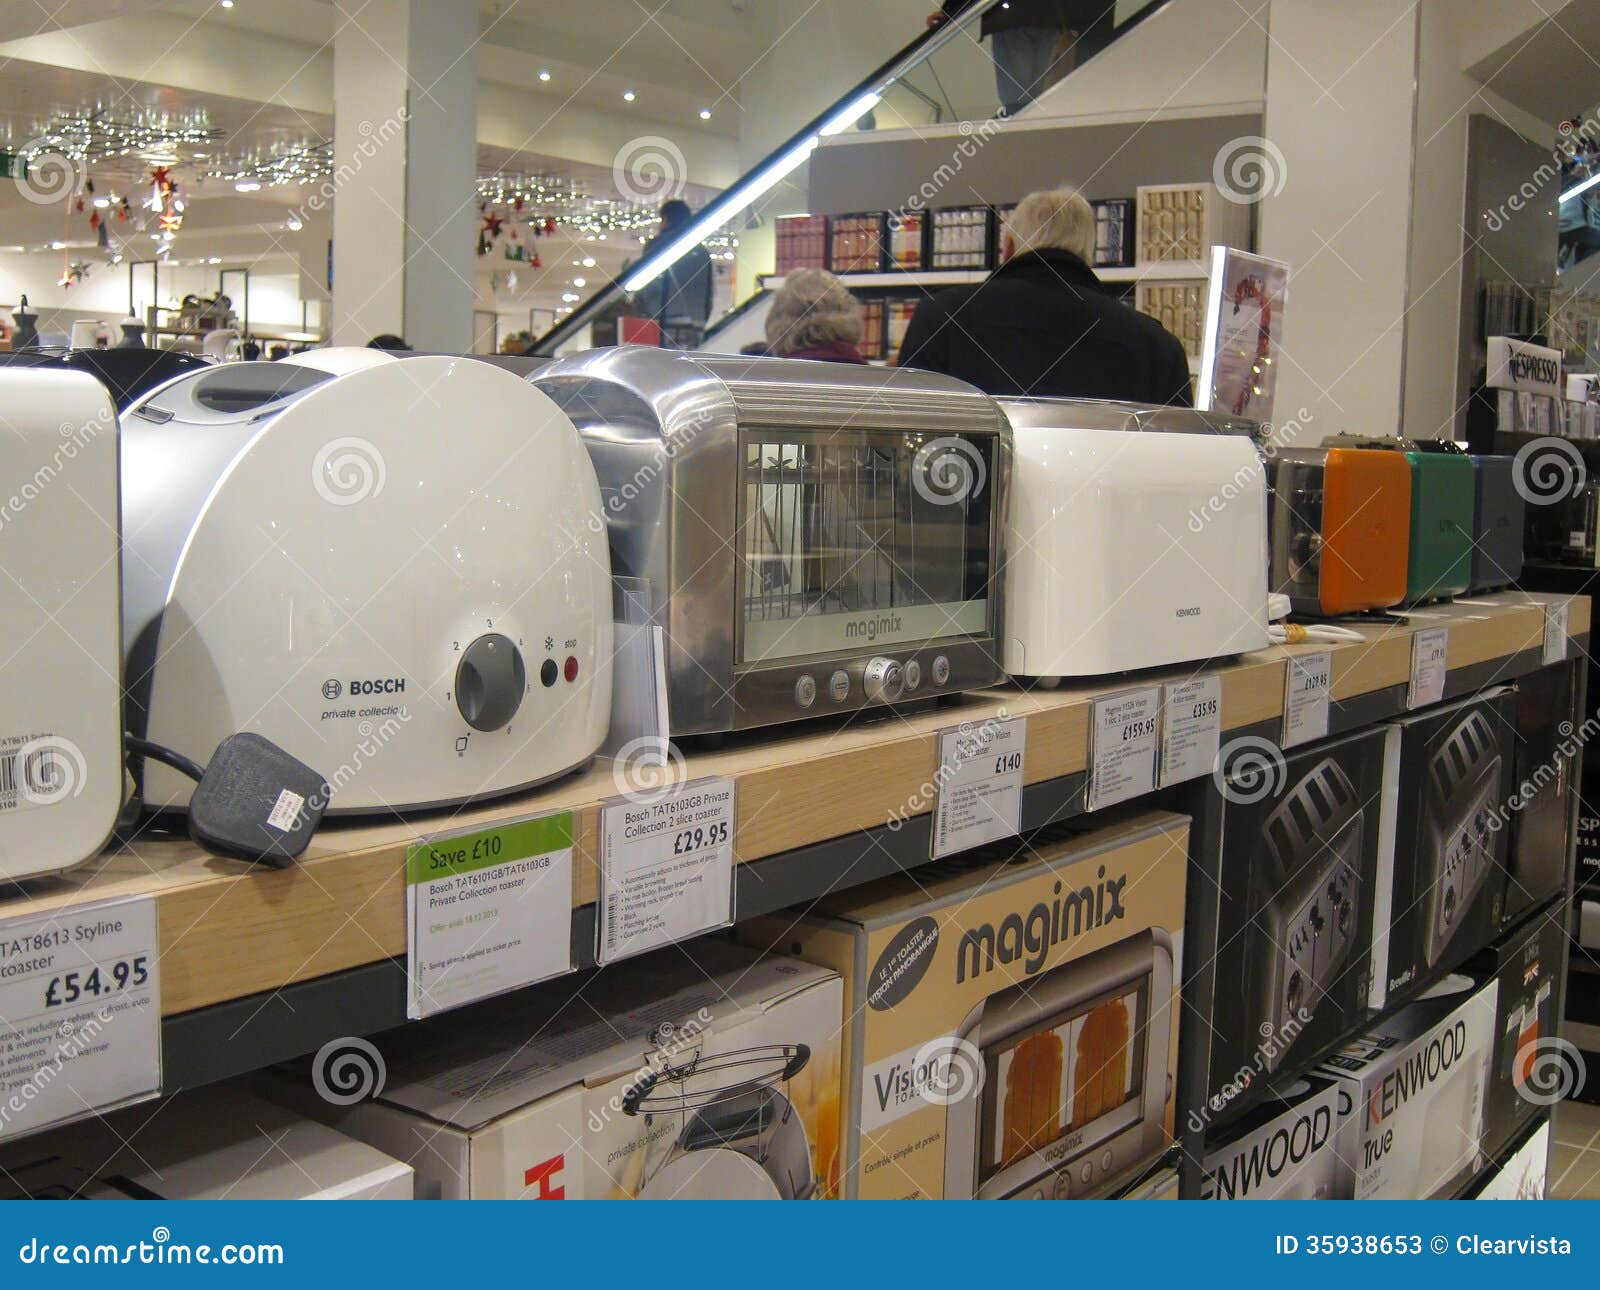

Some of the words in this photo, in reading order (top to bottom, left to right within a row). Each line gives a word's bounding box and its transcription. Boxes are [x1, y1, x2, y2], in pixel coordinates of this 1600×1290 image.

[1508, 344, 1558, 385] NESPRESSO
[845, 613, 902, 641] magimix
[453, 642, 460, 651] 2
[349, 678, 405, 696] BOSCH
[321, 708, 356, 720] private
[1193, 700, 1217, 719] £35.95
[1123, 718, 1155, 741] £159.95
[995, 753, 1021, 774] £140
[624, 820, 667, 839] Collection
[669, 816, 674, 828] 2
[676, 812, 693, 826] slice
[694, 806, 723, 820] toaster
[625, 808, 650, 824] Bosch
[652, 795, 702, 817] TAT6103GB
[703, 790, 730, 804] Private
[430, 848, 467, 870] Save
[472, 836, 502, 860] £10
[674, 821, 728, 855] £29.95
[430, 879, 454, 895] Bosch
[455, 856, 551, 891] TAT6101GB/TAT6103GB
[429, 891, 457, 908] Private
[458, 884, 498, 901] Collection
[499, 877, 526, 891] toaster
[0, 929, 70, 958] TAT8613
[75, 919, 123, 942] Styline
[956, 865, 1127, 984] magimix
[0, 955, 55, 979] toaster
[869, 975, 894, 1005] VISION
[892, 927, 939, 981] PANORAMIQUE
[879, 968, 888, 981] LE
[896, 928, 925, 962] TOASTER
[45, 956, 149, 1008] £54.95
[16, 1034, 52, 1050] memory
[27, 1019, 66, 1034] including
[873, 1057, 940, 1112] Vision
[1365, 1020, 1466, 1132] KENWOOD
[607, 1141, 637, 1165] private
[637, 1121, 676, 1149] collection
[892, 1144, 914, 1161] simple
[914, 1140, 922, 1151] et
[1044, 1132, 1083, 1163] magimix
[1364, 1129, 1393, 1169] True
